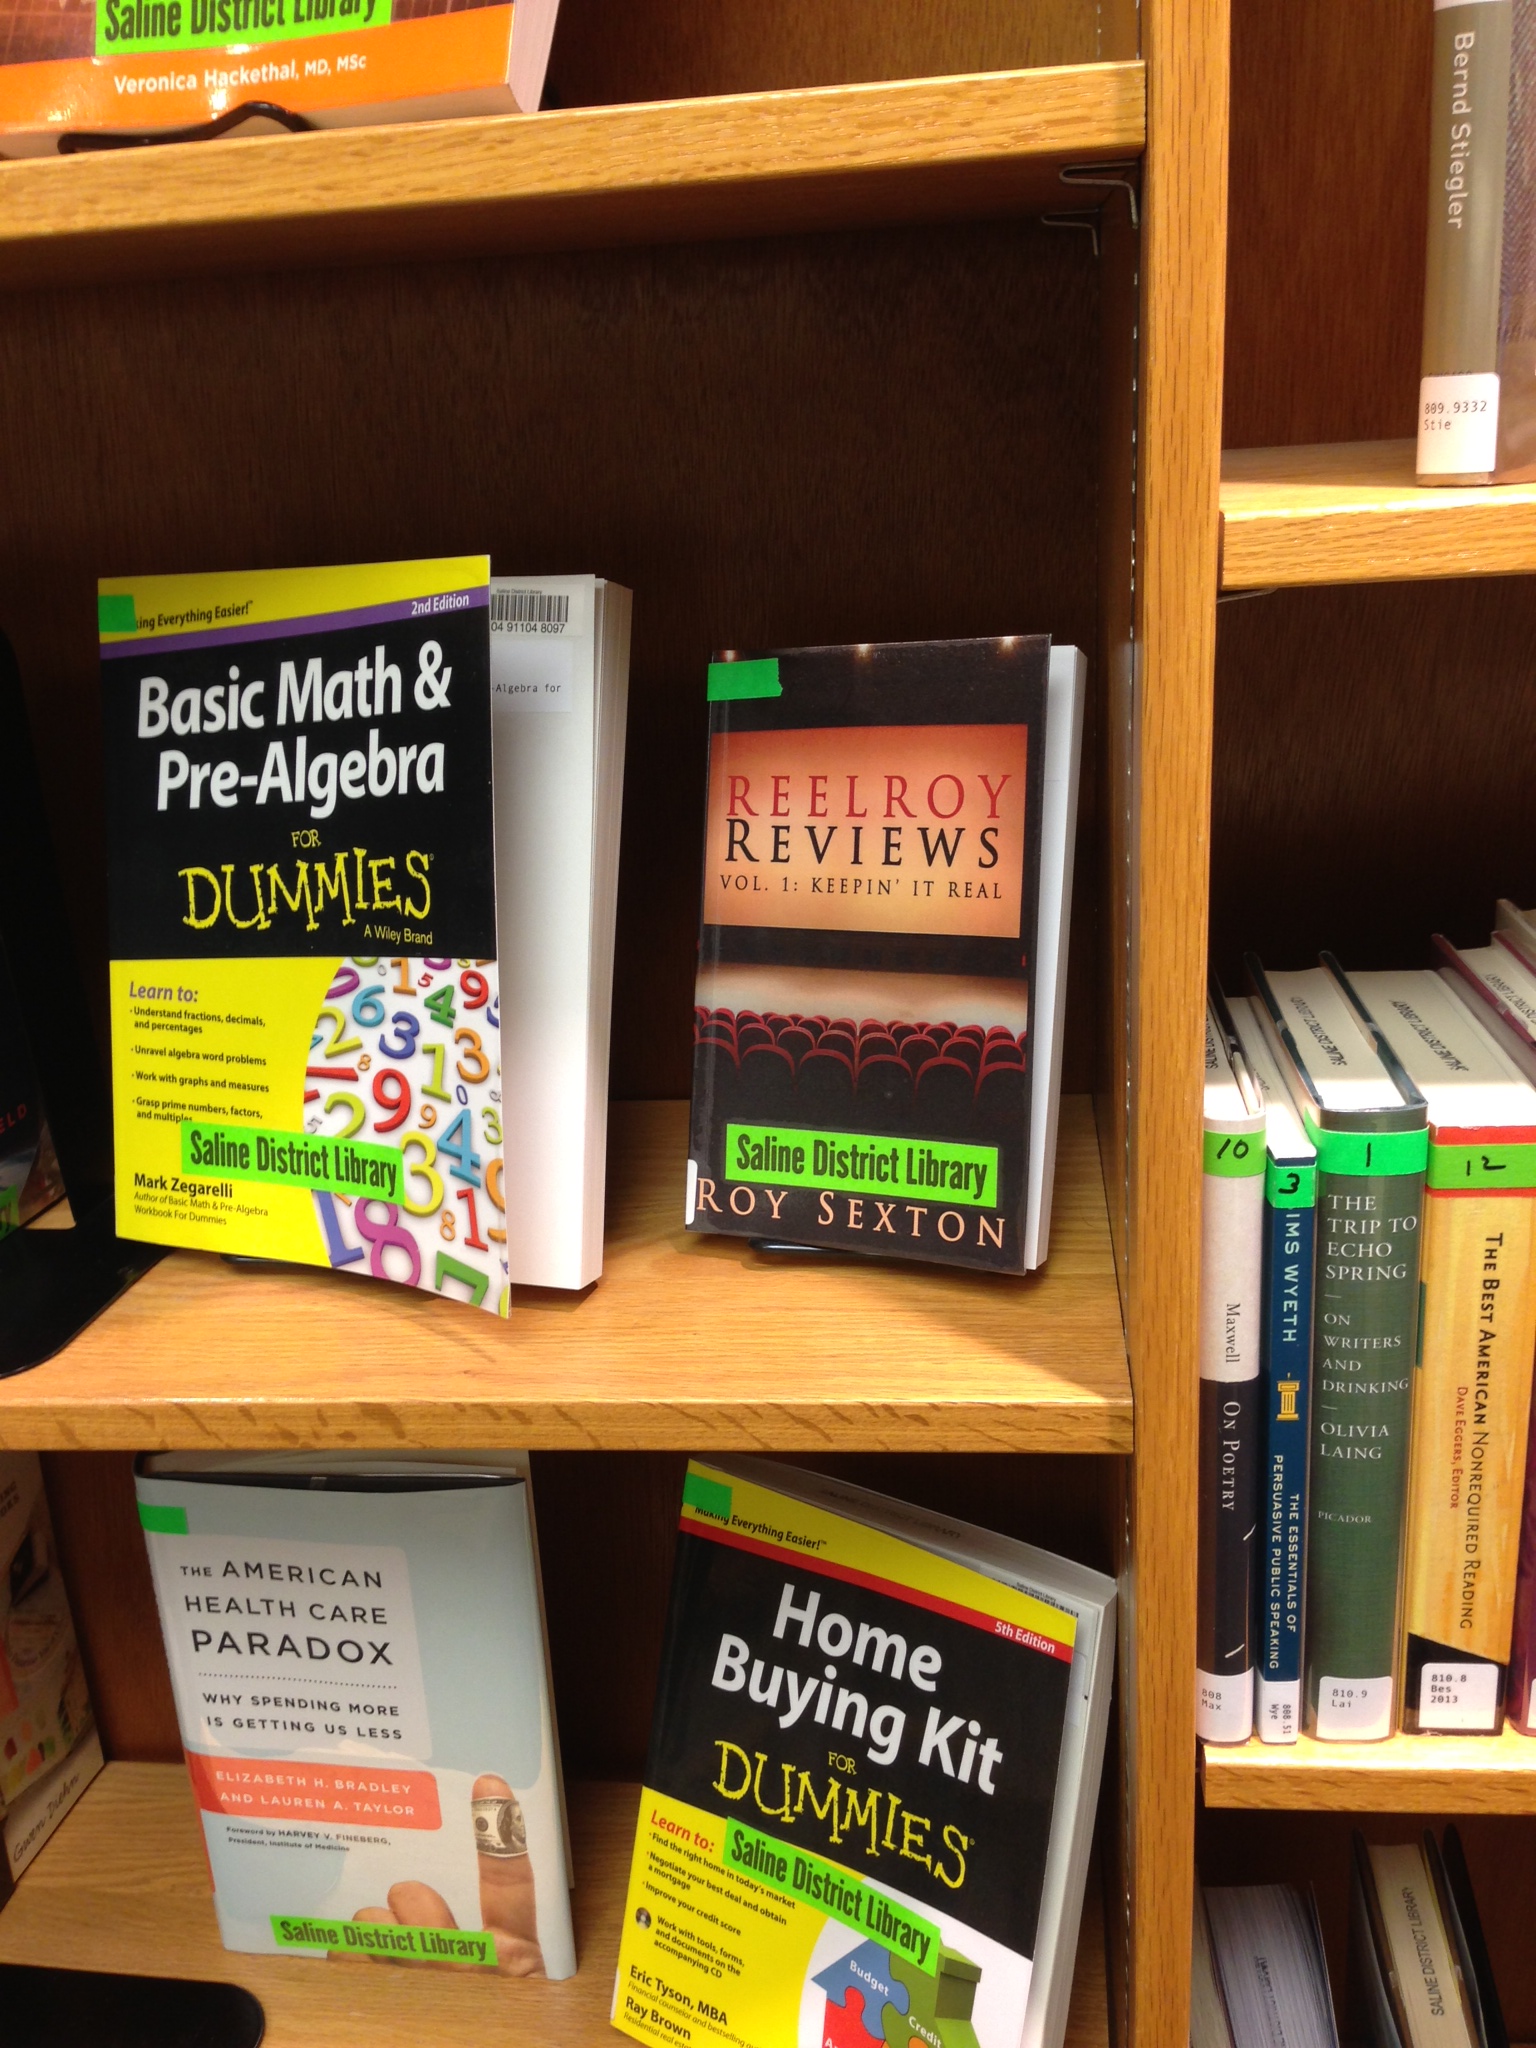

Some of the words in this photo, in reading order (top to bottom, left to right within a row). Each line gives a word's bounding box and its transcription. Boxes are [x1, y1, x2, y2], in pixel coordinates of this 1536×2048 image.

[105, 0, 181, 41] Saline
[114, 71, 197, 95] Veronica
[204, 59, 299, 88] Hackethal,
[304, 61, 331, 77] MD,
[337, 54, 366, 71] MSc
[1452, 31, 1475, 115] Bernd
[1445, 123, 1472, 229] Stiegler
[1424, 400, 1488, 415] 809.9332
[1423, 419, 1452, 431] Stie
[157, 609, 213, 628] Everything
[411, 597, 431, 615] 2nd
[433, 593, 469, 611] Edition
[506, 622, 538, 633] 91104
[540, 623, 565, 633] 8097
[137, 665, 264, 739] Basic
[276, 645, 402, 726] Math
[413, 639, 452, 711] &
[156, 729, 445, 818] Pre-Algebra
[726, 774, 1011, 819] REELROY
[291, 829, 321, 848] FOR
[725, 818, 999, 869] REVIEWS
[720, 874, 768, 892] VOL.
[782, 877, 798, 892] 1:
[913, 880, 935, 897] IT
[948, 881, 1002, 900] REAL
[364, 926, 373, 939] A
[374, 926, 402, 944] Wiley
[403, 928, 433, 945] Brand
[129, 981, 173, 1001] Learn
[177, 985, 199, 1003] to:
[133, 1006, 182, 1019] Understand
[184, 1010, 224, 1024] fractions,
[225, 1014, 266, 1027] decimals,
[134, 1020, 150, 1030] and
[151, 1021, 203, 1035] percentages
[135, 1071, 157, 1082] Work
[158, 1073, 177, 1084] with
[178, 1077, 209, 1088] graphs
[210, 1079, 227, 1089] and
[228, 1082, 270, 1093] measures
[190, 1129, 250, 1171] Saline
[256, 1135, 329, 1180] District
[335, 1145, 397, 1197] Library
[1216, 1138, 1250, 1160] 10
[736, 1134, 805, 1175] Saline
[812, 1138, 900, 1184] District
[906, 1147, 988, 1200] Library
[134, 1173, 168, 1190] Mark
[170, 1177, 233, 1198] Zegarelli
[1278, 1172, 1300, 1195] 3
[696, 1178, 789, 1220] ROY
[817, 1191, 1006, 1249] SEXTON
[1327, 1194, 1378, 1211] THE
[1284, 1211, 1301, 1256] IMS
[1327, 1217, 1382, 1235] TRIP
[1388, 1215, 1418, 1233] TO
[1327, 1241, 1393, 1258] ECHO
[1483, 1232, 1504, 1272] THE
[1325, 1263, 1407, 1281] SPRING
[1282, 1263, 1301, 1343] WYETH
[1480, 1278, 1501, 1324] BEST
[1225, 1303, 1241, 1364] Maxwell
[1324, 1313, 1351, 1326] ON
[1323, 1335, 1402, 1350] WRITERS
[1322, 1358, 1362, 1372] AND
[1473, 1329, 1497, 1425] AMERICAN
[1322, 1377, 1409, 1394] DRINKING
[1222, 1401, 1241, 1430] ON
[1455, 1386, 1469, 1417] DAVE
[1320, 1422, 1390, 1438] OLIVIA
[1320, 1443, 1382, 1460] LAING
[1221, 1439, 1241, 1512] POETRY
[1449, 1468, 1463, 1510] EDITOR
[1271, 1455, 1284, 1543] PERSUASIVE
[1465, 1431, 1489, 1554] NONREQUIRED
[1288, 1494, 1299, 1521] THE
[1318, 1510, 1372, 1524] PICADOR
[731, 1514, 785, 1542] Everything
[180, 1566, 213, 1577] THE
[222, 1560, 382, 1589] AMERICAN
[1270, 1548, 1282, 1598] PUBLIC
[1286, 1526, 1299, 1610] ESSENTIALS
[1460, 1559, 1481, 1630] READING
[184, 1595, 296, 1618] HEALTH
[308, 1603, 388, 1625] CARE
[1285, 1616, 1297, 1633] OF
[191, 1629, 393, 1666] PARADOX
[773, 1583, 942, 1693] Home
[994, 1621, 1013, 1638] 5th
[1014, 1628, 1056, 1654] Edition
[1268, 1602, 1281, 1670] SPEAKING
[1430, 1684, 1452, 1693] Bes
[1431, 1674, 1468, 1683] 810.8
[202, 1692, 243, 1706] WHY
[250, 1695, 341, 1713] SPENDING
[349, 1703, 400, 1717] MORE
[1201, 1699, 1221, 1711] Max
[1202, 1688, 1222, 1700] 808
[1331, 1699, 1352, 1708] Lai
[1332, 1689, 1368, 1698] 810.9
[1430, 1695, 1459, 1704] 2013
[207, 1716, 223, 1727] IS
[232, 1718, 315, 1733] GETTING
[324, 1724, 347, 1736] US
[357, 1727, 402, 1740] LESS
[711, 1633, 906, 1766] Buying
[918, 1706, 1004, 1795] Kit
[828, 1752, 857, 1776] FOR
[216, 1771, 306, 1787] ELIZABETH
[314, 1778, 329, 1789] H.
[335, 1779, 412, 1795] BRADLEY
[220, 1791, 253, 1804] AND
[260, 1795, 326, 1810] LAUREN
[333, 1800, 349, 1812] A.
[354, 1802, 415, 1817] TAYLOR
[651, 1809, 691, 1841] Learn
[693, 1832, 715, 1853] to:
[652, 1832, 669, 1847] Find
[669, 1843, 682, 1855] the
[683, 1849, 703, 1866] right
[703, 1858, 725, 1875] home
[726, 1869, 735, 1880] in
[766, 1890, 796, 1909] market
[731, 1829, 788, 1883] Saline
[792, 1856, 863, 1925] District
[866, 1895, 932, 1966] Library
[280, 1920, 339, 1945] Saline
[346, 1925, 415, 1952] District
[421, 1932, 487, 1962] Library
[1411, 1927, 1436, 1977] DISTRICT
[849, 1959, 890, 1998] Budget
[630, 1964, 653, 1988] Eric
[654, 1976, 694, 2009] Tyson,
[697, 2000, 728, 2026] MBA
[1423, 1976, 1445, 2017] SALINE
[626, 1995, 648, 2018] Ray
[649, 2011, 692, 2041] Brown
[908, 2015, 943, 2047] Credit
